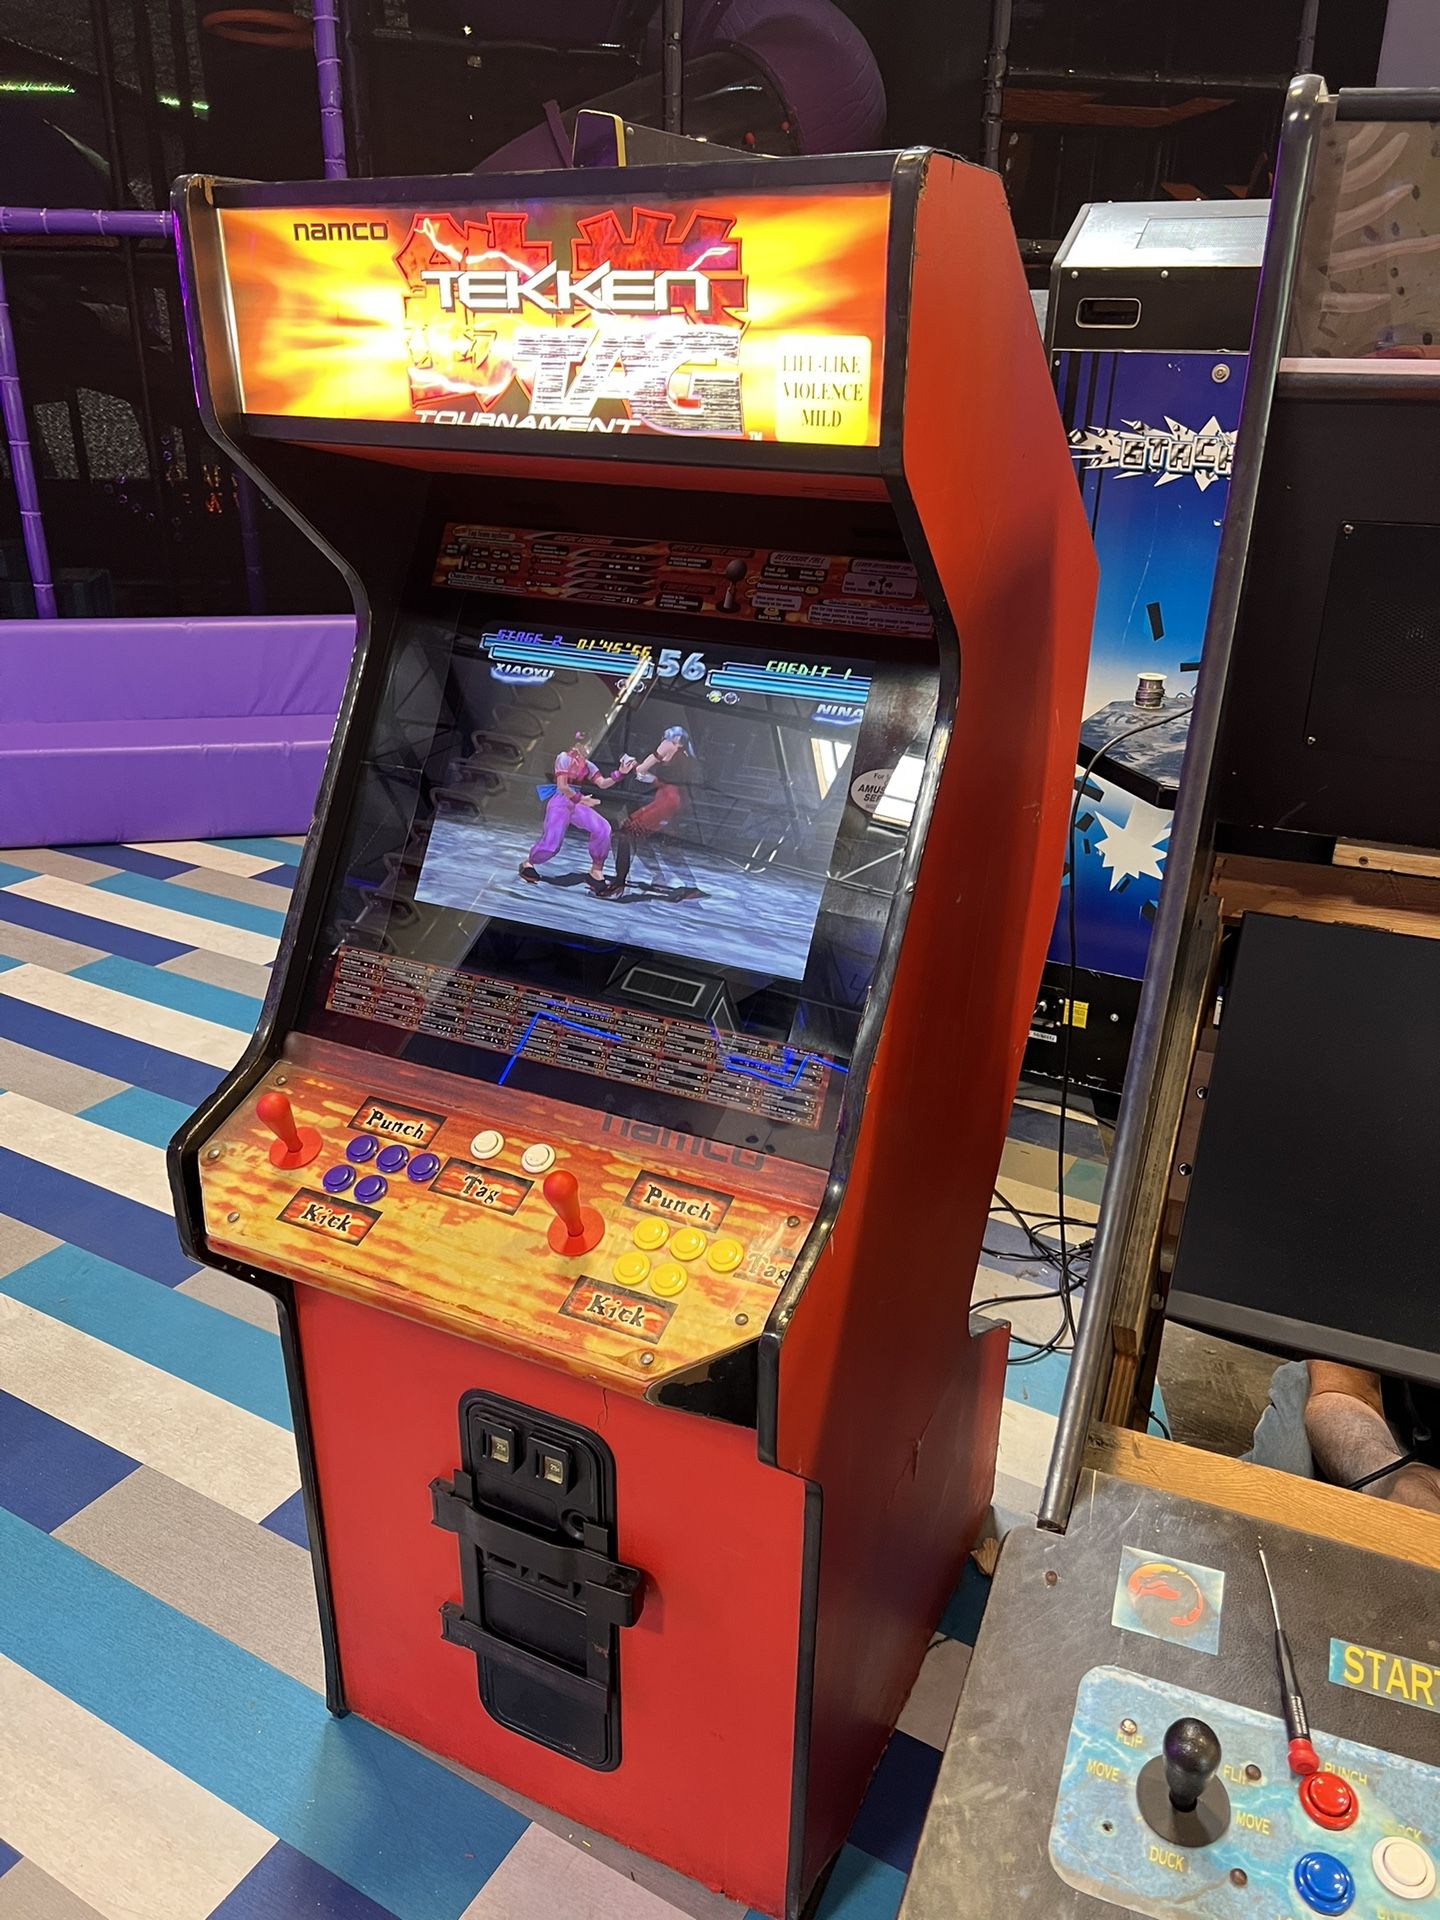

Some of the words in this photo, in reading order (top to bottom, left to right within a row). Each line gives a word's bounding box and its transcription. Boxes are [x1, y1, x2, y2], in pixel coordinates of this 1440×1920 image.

[293, 222, 389, 241] namco
[420, 259, 712, 314] TEKKEN
[513, 323, 746, 436] TAG
[783, 381, 863, 401] VIOLENCE
[413, 409, 643, 434] TOURNAMENT
[802, 409, 842, 428] MILD
[496, 629, 543, 645] STAGE
[552, 635, 564, 647] 2
[494, 663, 555, 678] XIAOYU
[657, 648, 707, 681] 56
[766, 660, 831, 677] CREDIT
[816, 704, 865, 717] NINA
[366, 1108, 424, 1139] Punch
[463, 1173, 499, 1205] Tag
[643, 1184, 711, 1221] Punch
[301, 1204, 351, 1232] Kick
[748, 1252, 789, 1285] Tag
[587, 1294, 645, 1327] Kick
[1343, 1645, 1440, 1706] STAR
[1116, 1730, 1144, 1749] FLIP
[1086, 1758, 1121, 1784] MOVE
[1222, 1764, 1249, 1785] FLI
[1324, 1762, 1368, 1785] PUNCH
[1235, 1810, 1272, 1836] MOVE
[1149, 1846, 1186, 1873] DUCK
